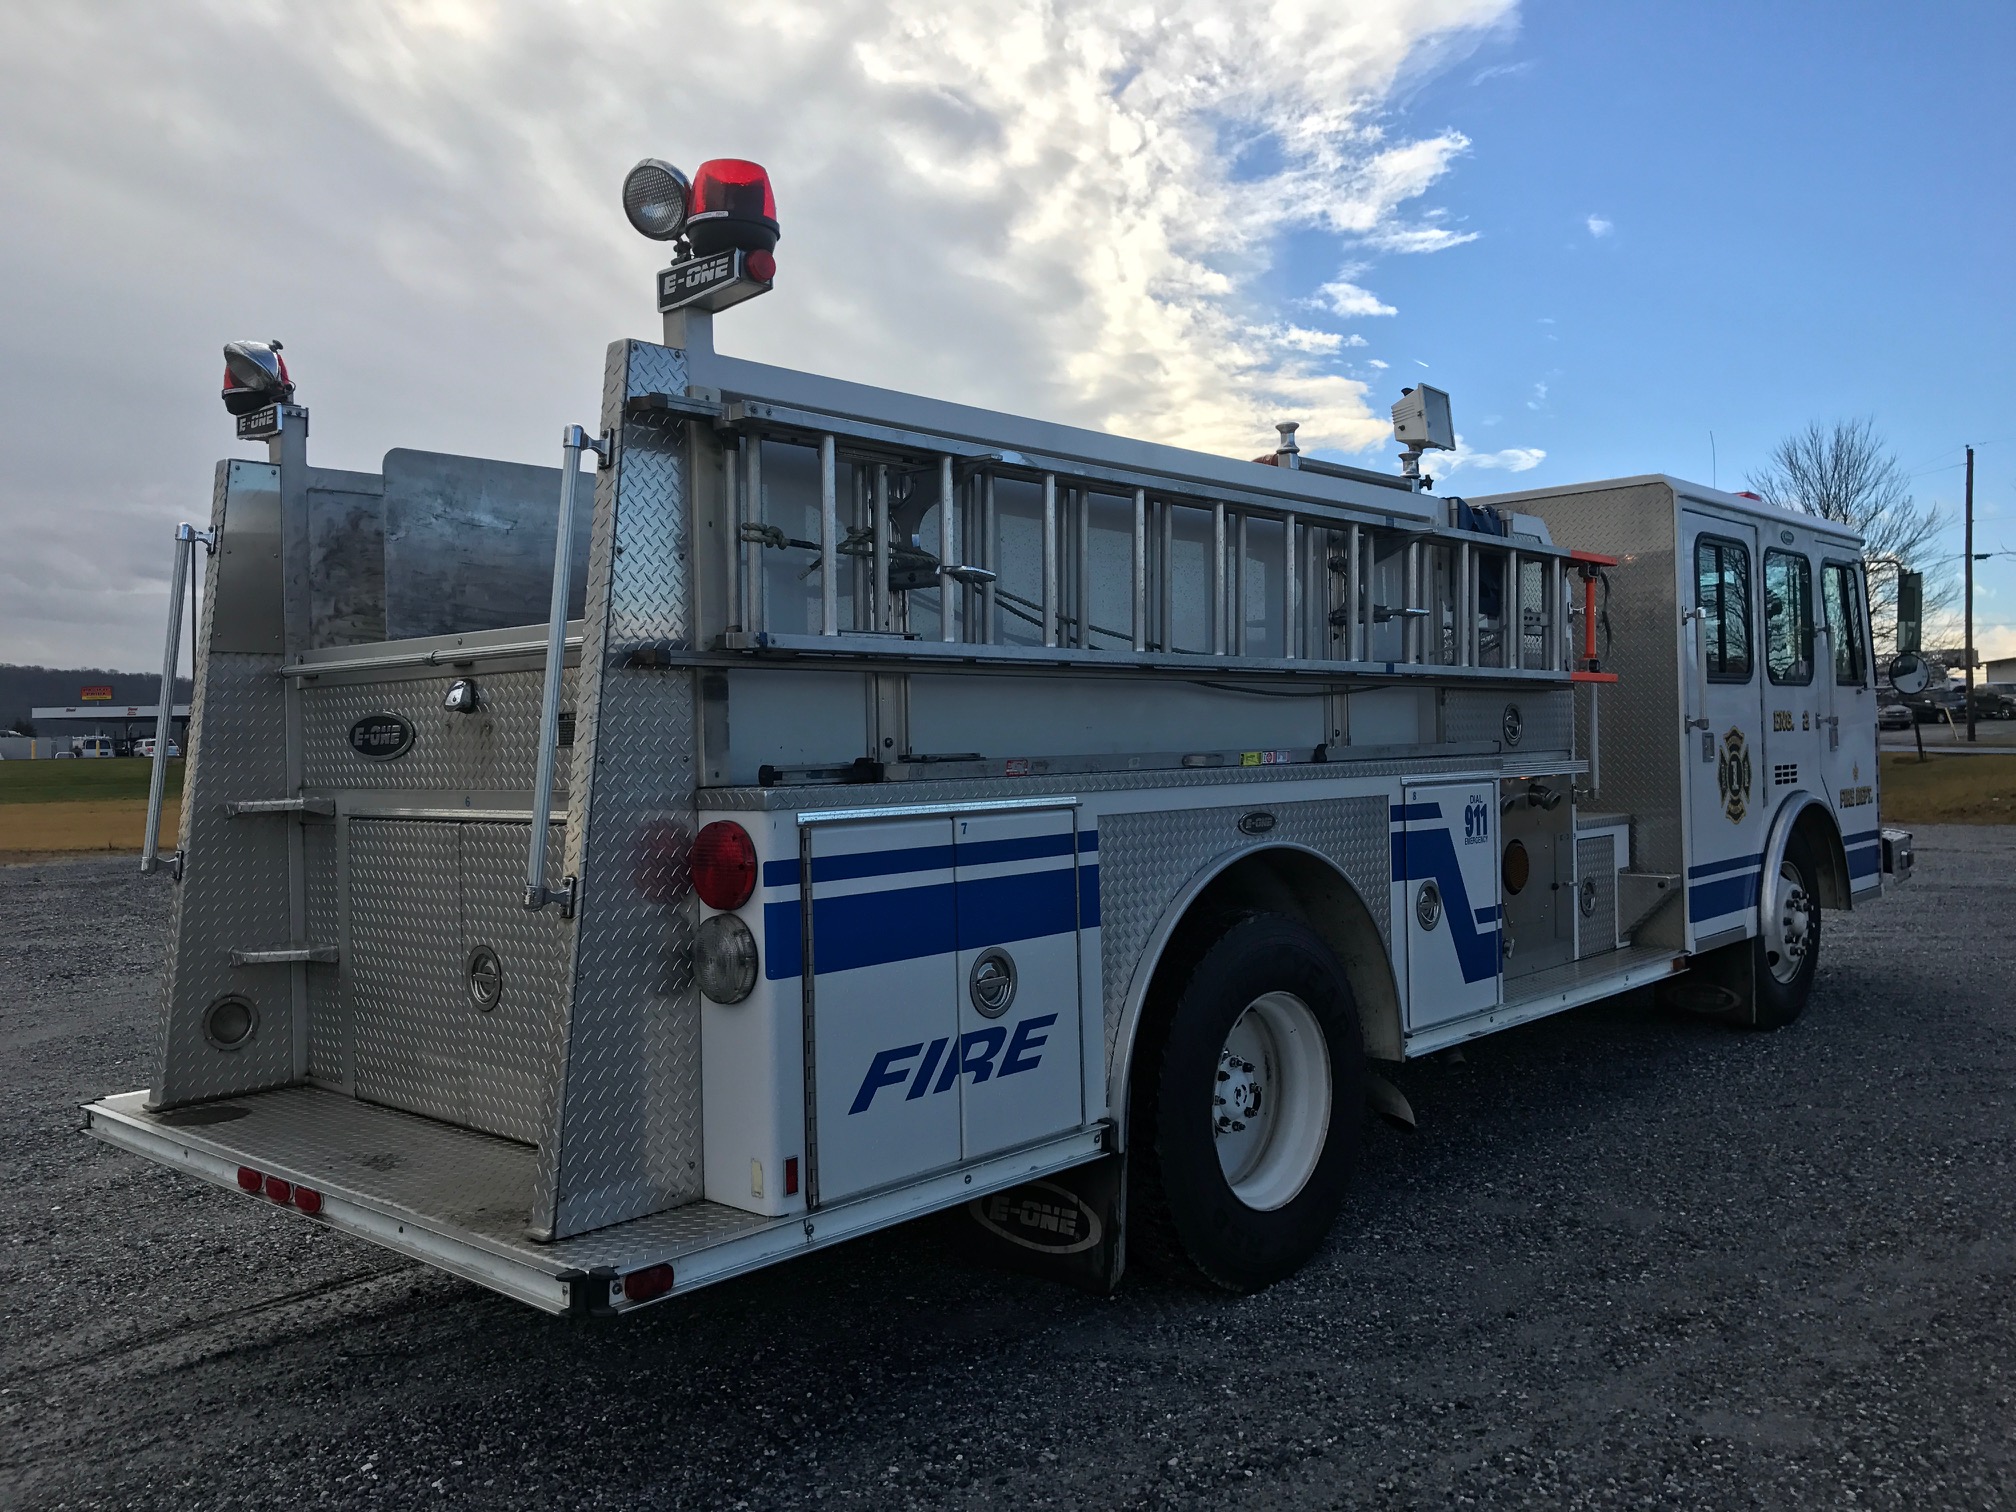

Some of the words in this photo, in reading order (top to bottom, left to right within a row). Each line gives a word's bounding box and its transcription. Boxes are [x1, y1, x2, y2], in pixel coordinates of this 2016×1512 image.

[663, 256, 730, 296] E-ONE
[238, 409, 274, 433] E-ONE
[353, 724, 402, 746] E-ONE
[465, 796, 471, 807] 6
[1412, 791, 1417, 801] 8
[1469, 794, 1483, 804] DIAL
[960, 822, 968, 835] 7
[1245, 817, 1273, 829] E-ONE
[1464, 803, 1488, 838] 911
[1464, 835, 1489, 846] EMERGENCY
[847, 1012, 1059, 1116] FIRE
[989, 1195, 1078, 1237] E-ONE
